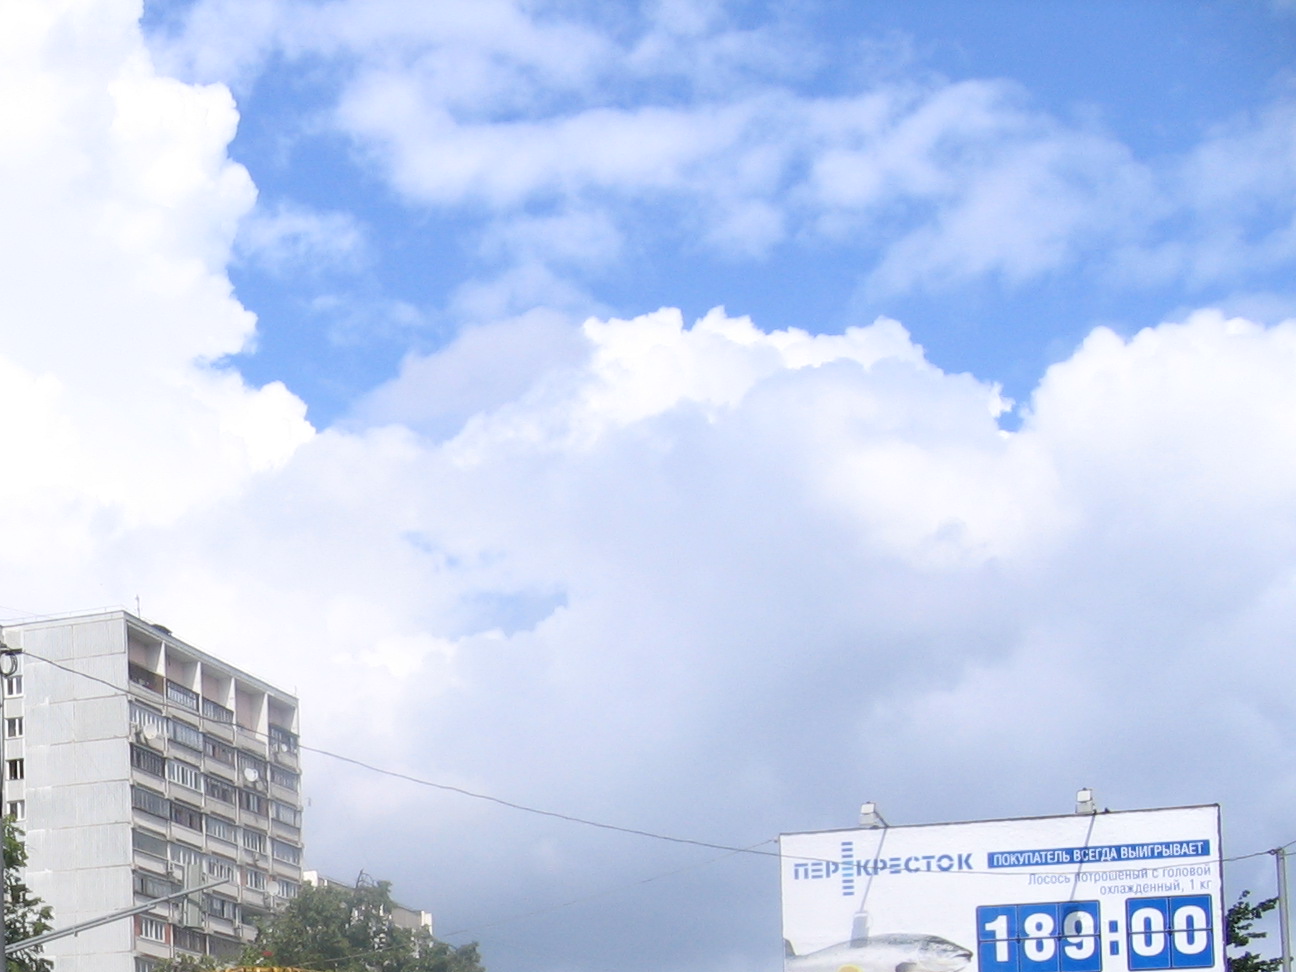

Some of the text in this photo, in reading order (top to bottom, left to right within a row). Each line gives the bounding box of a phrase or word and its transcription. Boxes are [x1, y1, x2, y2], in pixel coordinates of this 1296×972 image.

[993, 842, 1204, 866] ПОКУПАТЕЛЬ ВСЕГДА ВЫИГРЫВАЕТ
[794, 842, 974, 896] ПЕРЕКРЕСТОК
[1028, 873, 1071, 885] Лосось
[1075, 867, 1148, 884] потрошеный
[1163, 863, 1212, 878] головой
[1100, 879, 1212, 895] охлажденный, 1 кг
[984, 905, 1208, 963] 189:00
